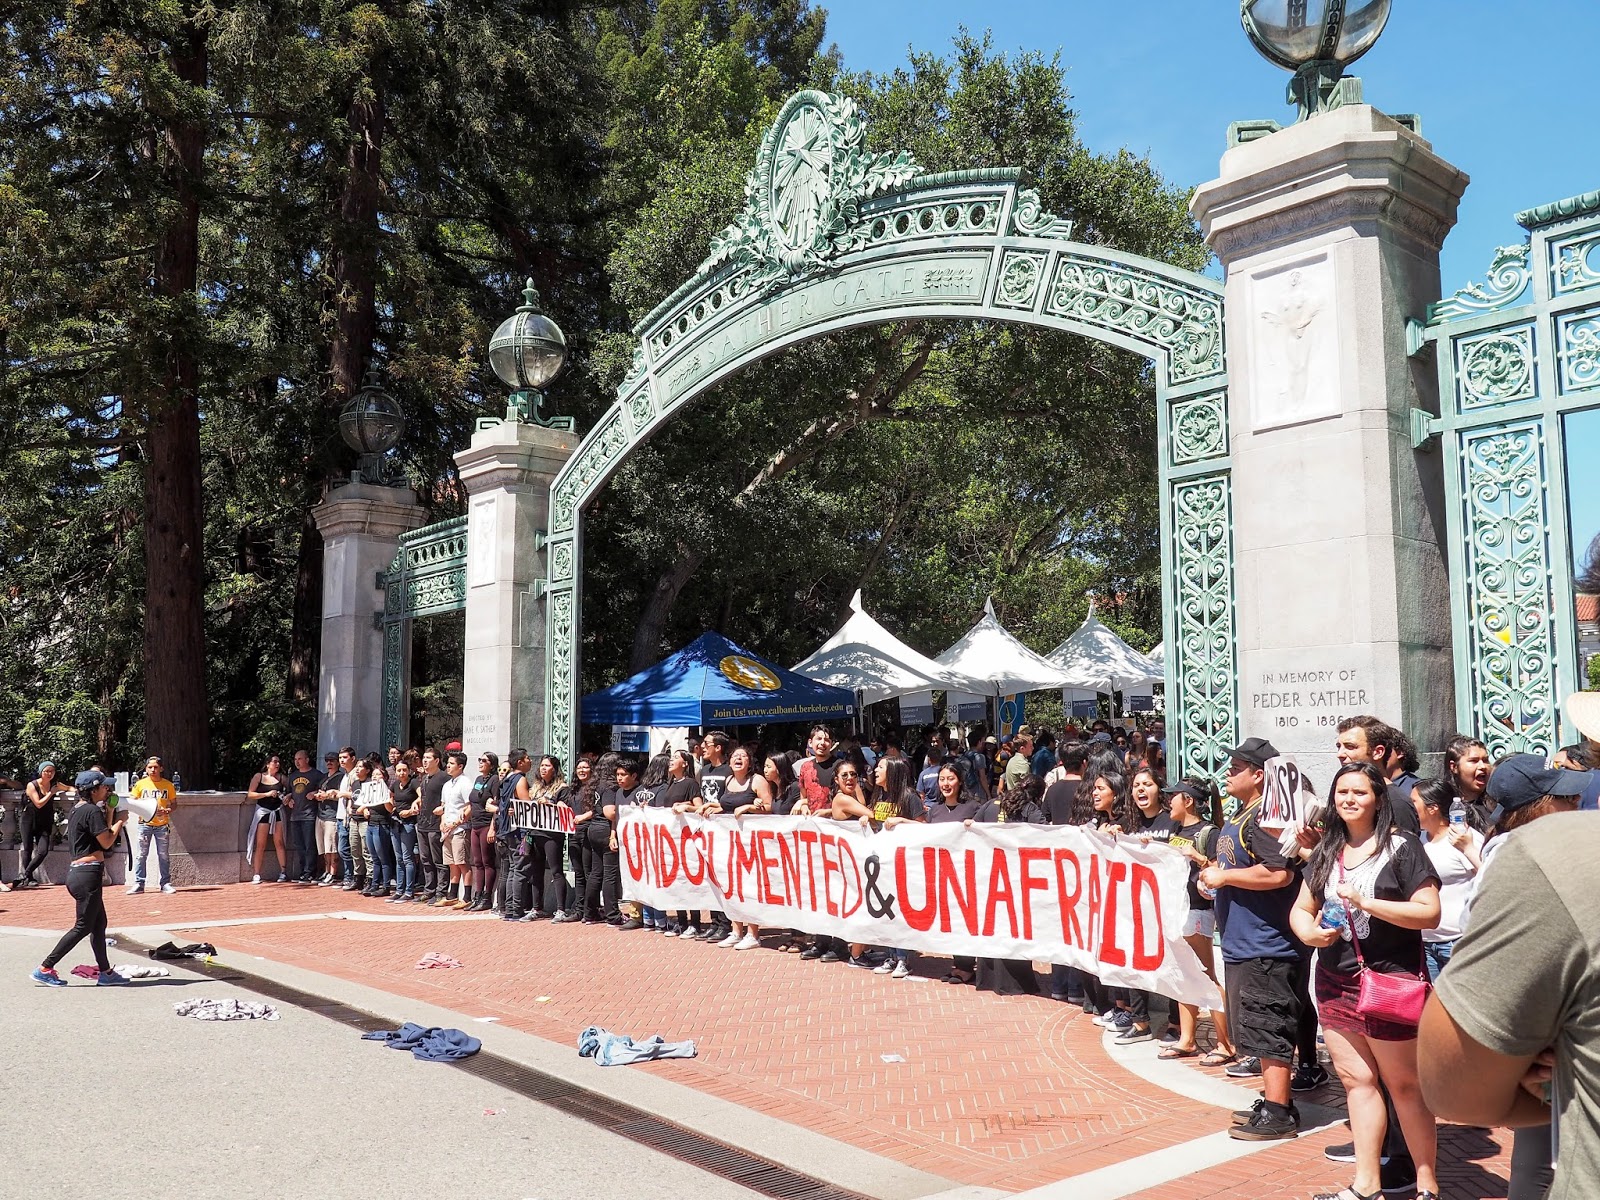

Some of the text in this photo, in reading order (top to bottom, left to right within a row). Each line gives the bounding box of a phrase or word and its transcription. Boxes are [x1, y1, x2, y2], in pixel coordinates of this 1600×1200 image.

[706, 266, 917, 365] SATHER GATE
[1263, 670, 1356, 684] IN MEMORY OF
[1253, 689, 1370, 709] PEDER SATHER
[713, 703, 844, 718] Join Us! www.calband.berkeley.edu
[947, 705, 958, 714] 58
[1275, 716, 1299, 727] 1810
[510, 800, 576, 832] NAPOLITANO
[865, 852, 896, 920] &
[895, 846, 1165, 972] UNAFRAID
